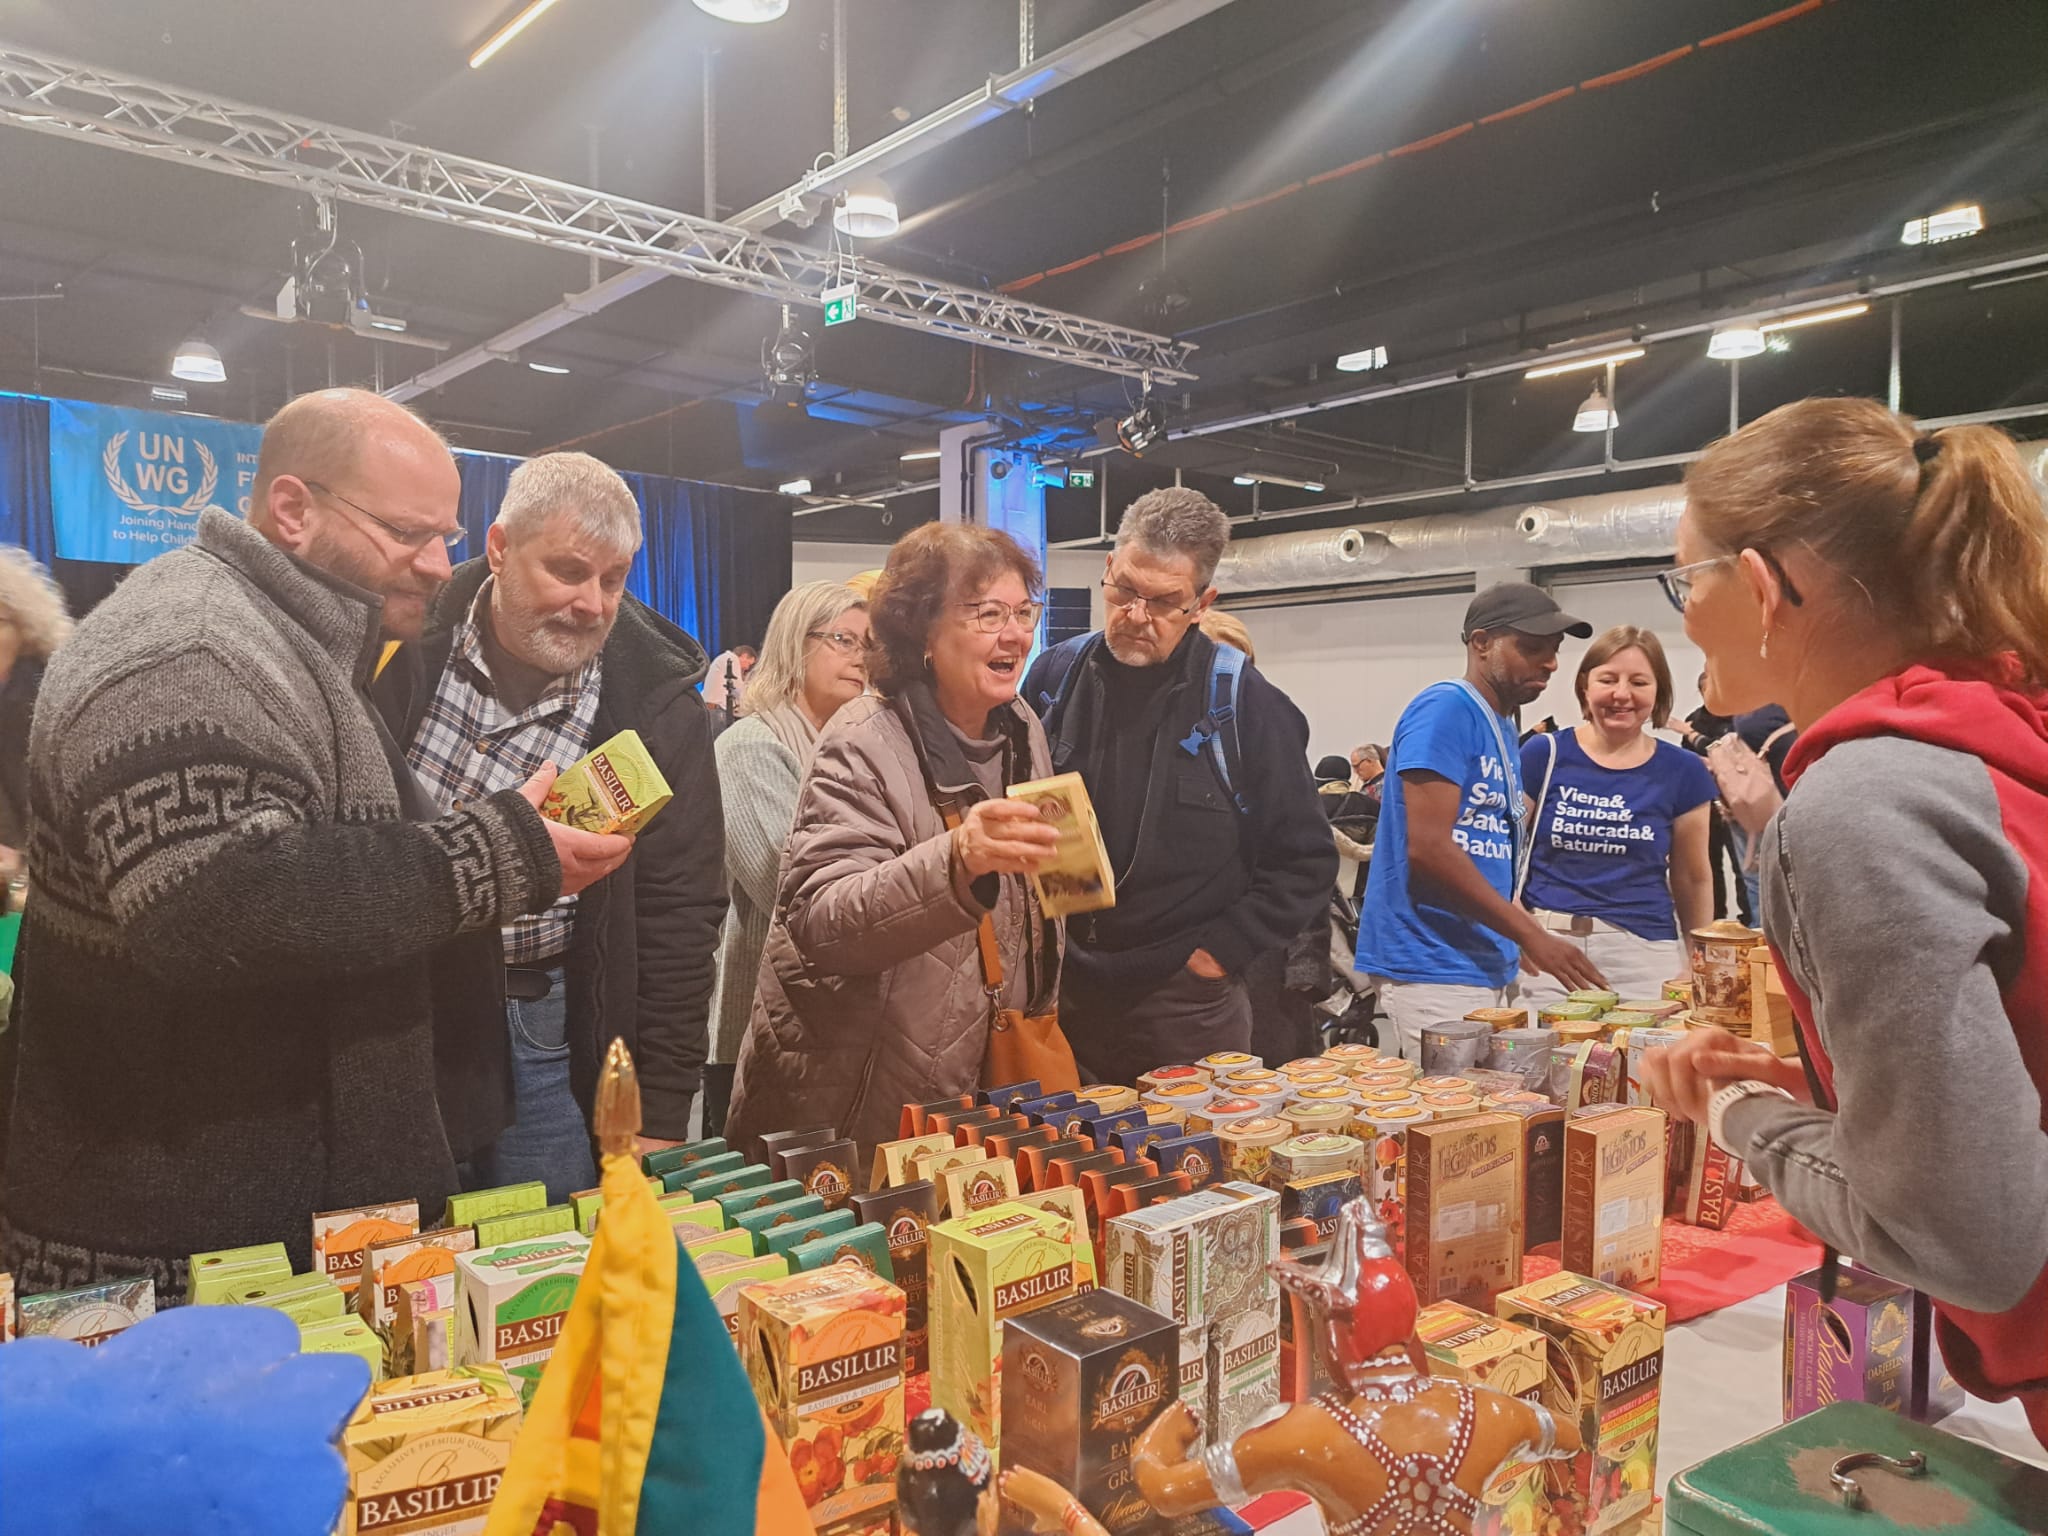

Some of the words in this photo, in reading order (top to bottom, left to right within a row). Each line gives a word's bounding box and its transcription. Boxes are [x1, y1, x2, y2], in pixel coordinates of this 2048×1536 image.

[139, 431, 184, 464] UN
[135, 462, 189, 495] WG
[112, 529, 127, 541] to
[129, 530, 159, 544] Help
[161, 533, 194, 546] Child
[120, 514, 165, 530] Joining
[593, 754, 632, 813] BASILUR
[1558, 786, 1626, 809] Viena&
[1551, 817, 1656, 841] Batucada&
[1555, 802, 1634, 822] Samba&
[1551, 833, 1627, 855] Baturim
[1701, 1145, 1728, 1225] BASILU
[1567, 1149, 1594, 1269] ASILUR
[995, 1266, 1073, 1310] BASILUR
[1124, 1254, 1136, 1299] SILUR
[1174, 1237, 1187, 1325] BASILUR
[498, 1315, 562, 1349] BASIL
[799, 1345, 898, 1393] BASILUR
[1224, 1334, 1276, 1372] BASILUR
[1602, 1356, 1659, 1401] BASILUR
[1882, 1379, 1897, 1393] TEA
[374, 1386, 481, 1413] BASILUR
[1101, 1383, 1158, 1418] BASILUR
[371, 1447, 416, 1491] EXCLUSIVE
[418, 1435, 466, 1451] PREMIUM
